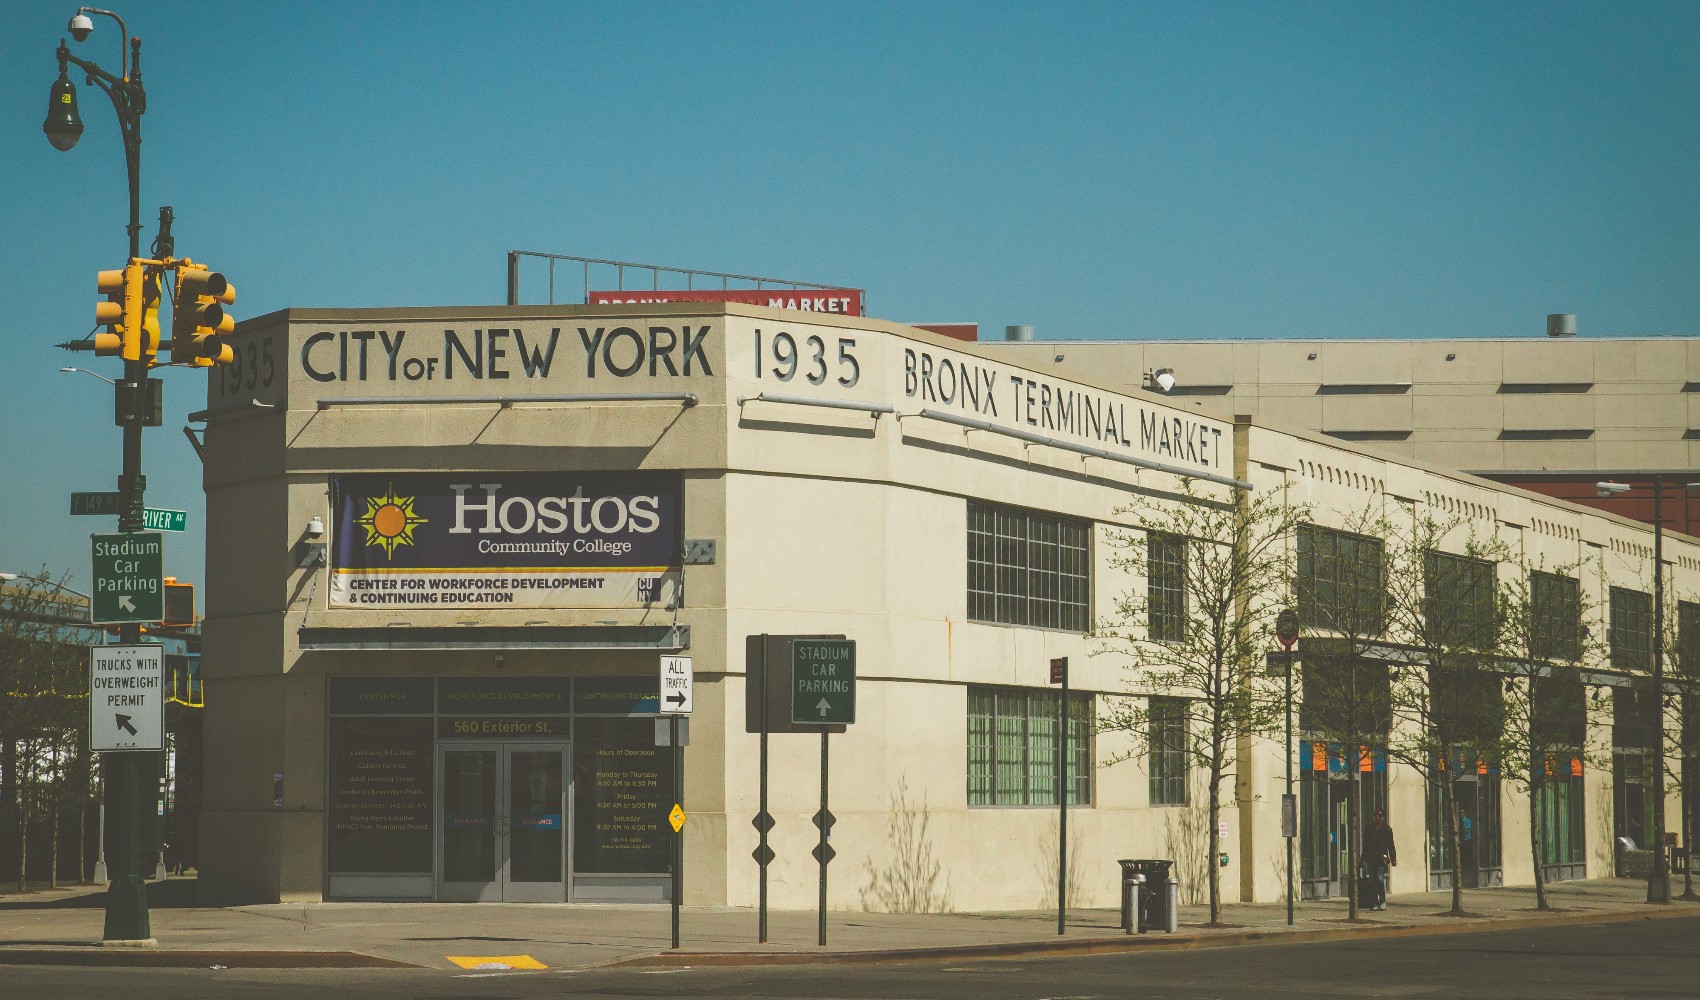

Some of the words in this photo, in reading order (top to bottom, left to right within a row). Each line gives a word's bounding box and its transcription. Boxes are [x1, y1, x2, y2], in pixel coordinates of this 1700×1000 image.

[768, 298, 851, 312] MARKET
[300, 330, 406, 382] CITY
[402, 357, 439, 381] OF
[445, 327, 561, 380] NEW
[577, 325, 714, 379] YORK
[755, 328, 860, 389] 1935
[218, 336, 276, 398] 1935
[904, 347, 998, 418] BRONX
[1010, 375, 1131, 448] TERMINAL
[1140, 408, 1222, 469] MARKET
[85, 496, 101, 512] 149
[448, 483, 660, 535] Hostos
[142, 510, 172, 528] RIVER
[95, 540, 159, 557] Stadium
[478, 539, 570, 556] Community
[573, 538, 632, 556] College
[114, 559, 141, 574] Car
[98, 576, 158, 594] Parking
[349, 579, 398, 590] CENTER
[400, 579, 426, 590] FOR
[428, 578, 509, 590] WORKFORCE
[511, 578, 605, 589] DEVELOPMENT
[349, 593, 358, 604] &
[360, 593, 439, 604] CONTINUING
[440, 592, 514, 603] EDUCATION
[799, 647, 849, 660] STADIUM
[96, 659, 132, 671] TRUCKS
[136, 658, 158, 670] WITH
[668, 660, 685, 675] ALL
[812, 663, 837, 676] CAR
[94, 677, 160, 689] OVERWEIGHT
[665, 677, 688, 689] TRAFFIC
[799, 680, 849, 693] PARKING
[108, 694, 146, 707] PERMIT
[447, 692, 496, 700] WORKFORCE
[498, 692, 555, 700] DEVELOPMENT
[579, 692, 628, 700] CONTINUING
[629, 692, 661, 700] EDUCAT
[454, 721, 479, 733] 560
[482, 720, 532, 733] Exterior
[535, 721, 552, 733] St.
[624, 749, 655, 757] Operation
[597, 771, 621, 779] Monday
[630, 771, 658, 779] Thursday
